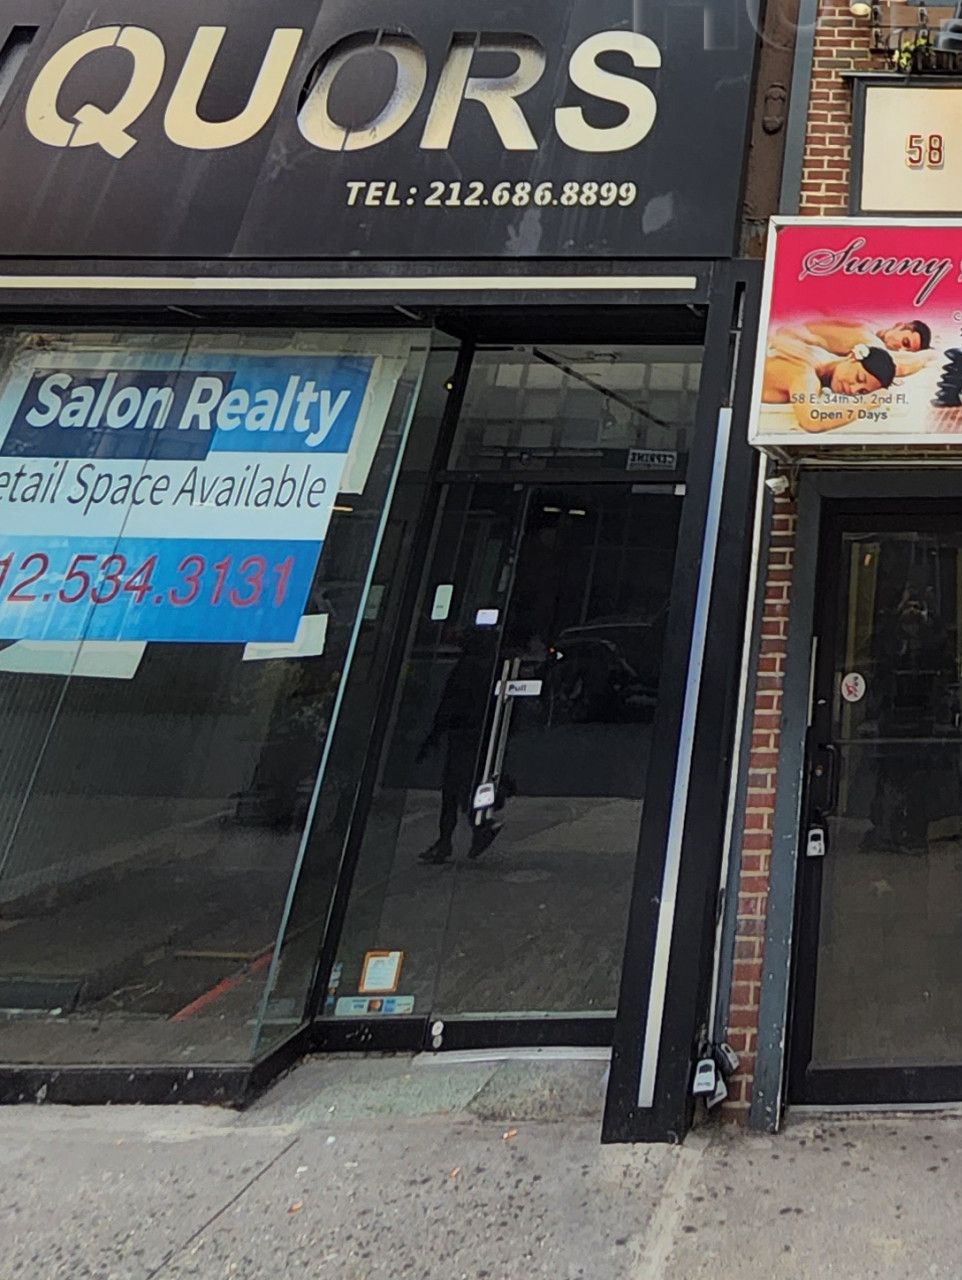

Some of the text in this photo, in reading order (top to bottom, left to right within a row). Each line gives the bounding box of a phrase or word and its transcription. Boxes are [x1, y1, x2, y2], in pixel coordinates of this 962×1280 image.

[906, 133, 946, 169] 58
[425, 181, 638, 208] 212.686.8899
[798, 237, 952, 307] Sunny
[25, 372, 351, 447] Salon Realty
[810, 409, 889, 422] Open 7 Days
[823, 393, 849, 404] 34th
[870, 393, 893, 404] 2nd
[67, 462, 171, 516] Space
[173, 464, 328, 509] Available
